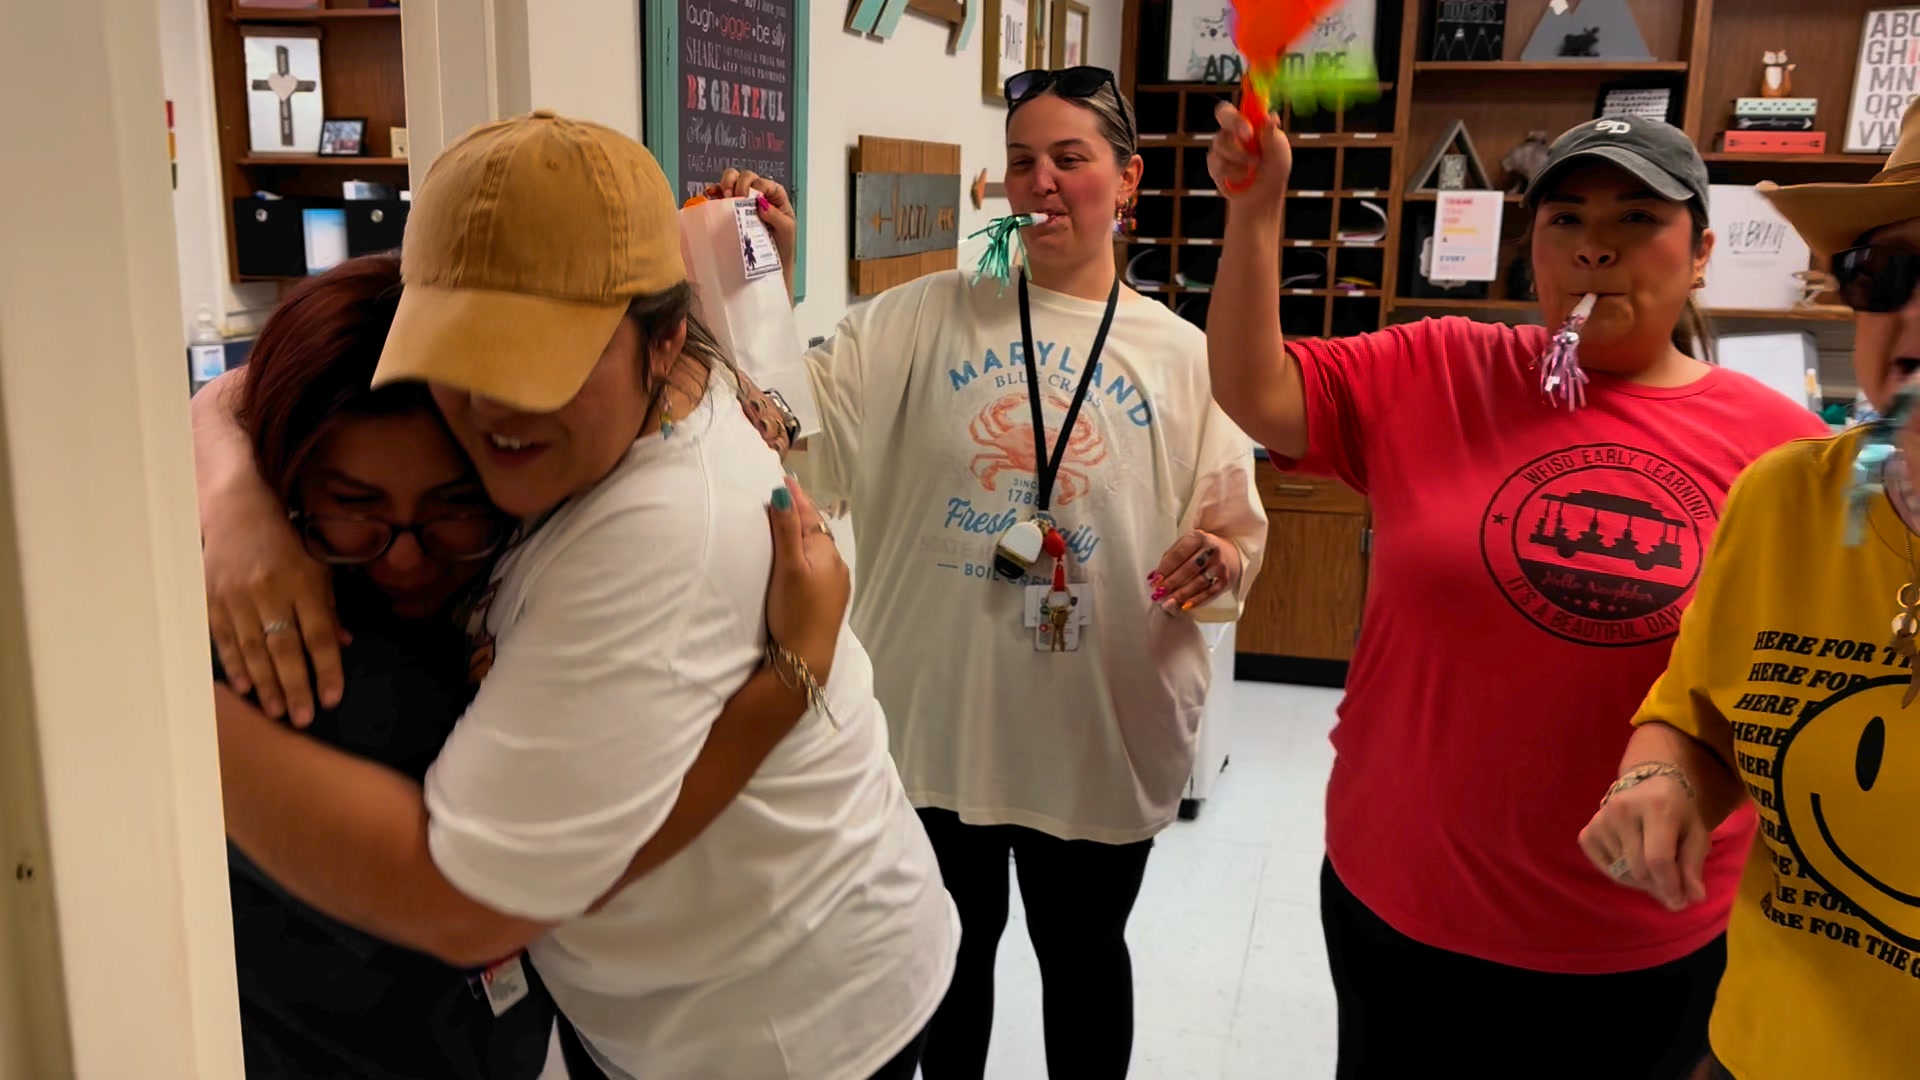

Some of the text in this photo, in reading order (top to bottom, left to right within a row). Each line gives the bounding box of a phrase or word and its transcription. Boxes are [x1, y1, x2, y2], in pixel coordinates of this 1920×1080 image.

[686, 0, 786, 53] laugh giggle be silly
[686, 36, 720, 70] SHARE
[723, 60, 738, 73] KEEP
[687, 74, 785, 122] BE GRATEFUL
[687, 154, 704, 172] TAKE
[706, 155, 714, 172] A
[1013, 478, 1038, 490] SINC
[1522, 448, 1711, 521] WFISD EARLY LEARNING
[944, 497, 1017, 536] Fresh
[964, 562, 1000, 582] BOIL
[1504, 575, 1537, 606] IT'S
[1531, 601, 1549, 620] A
[1551, 610, 1641, 640] BEAUTIFUL
[1753, 630, 1819, 656] HERE
[1816, 638, 1877, 663] FOR
[1747, 662, 1810, 686] HERE
[1733, 693, 1800, 716] HERE
[1731, 720, 1787, 748] HERE
[1809, 917, 1861, 948] FOR
[1865, 934, 1910, 971] THE
